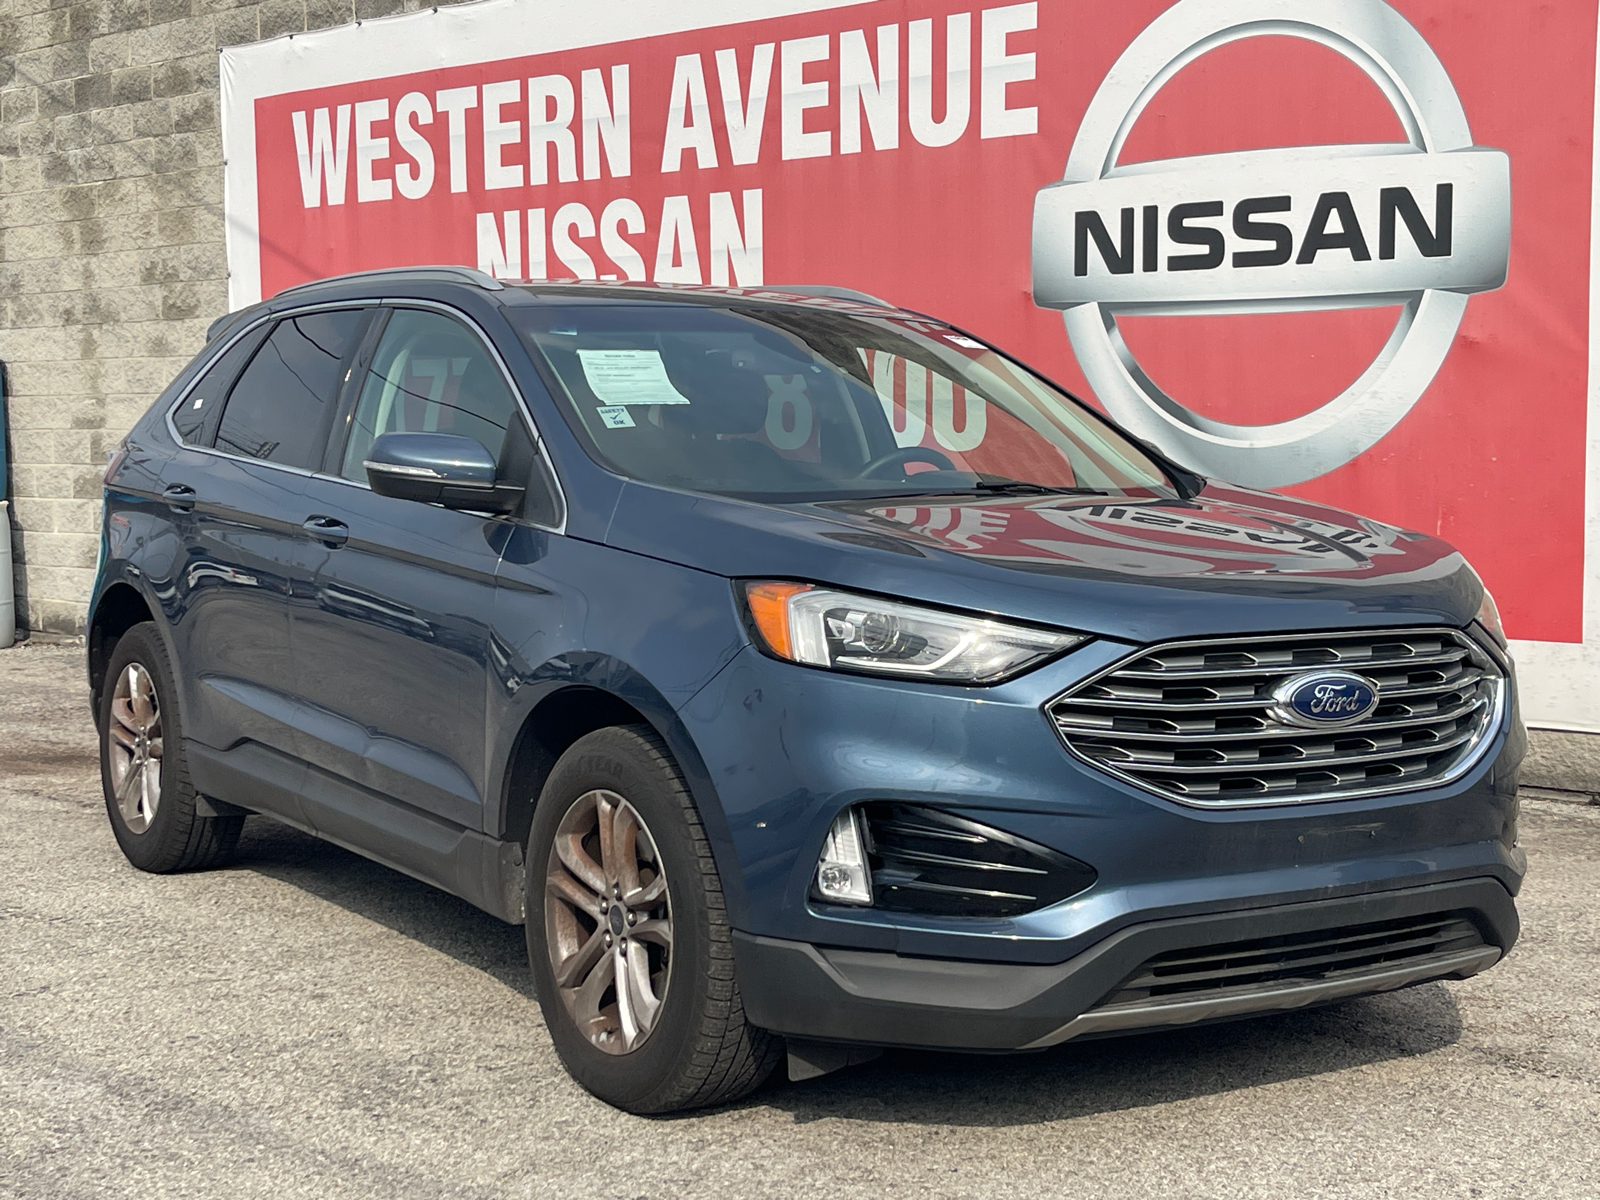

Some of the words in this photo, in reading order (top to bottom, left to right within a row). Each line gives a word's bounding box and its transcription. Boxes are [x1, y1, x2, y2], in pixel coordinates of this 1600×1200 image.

[291, 63, 632, 209] WESTERN
[660, 1, 1038, 174] AVENUE
[476, 188, 764, 287] NISSAN
[1074, 182, 1453, 277] NISSAN
[1310, 684, 1360, 713] Ford
